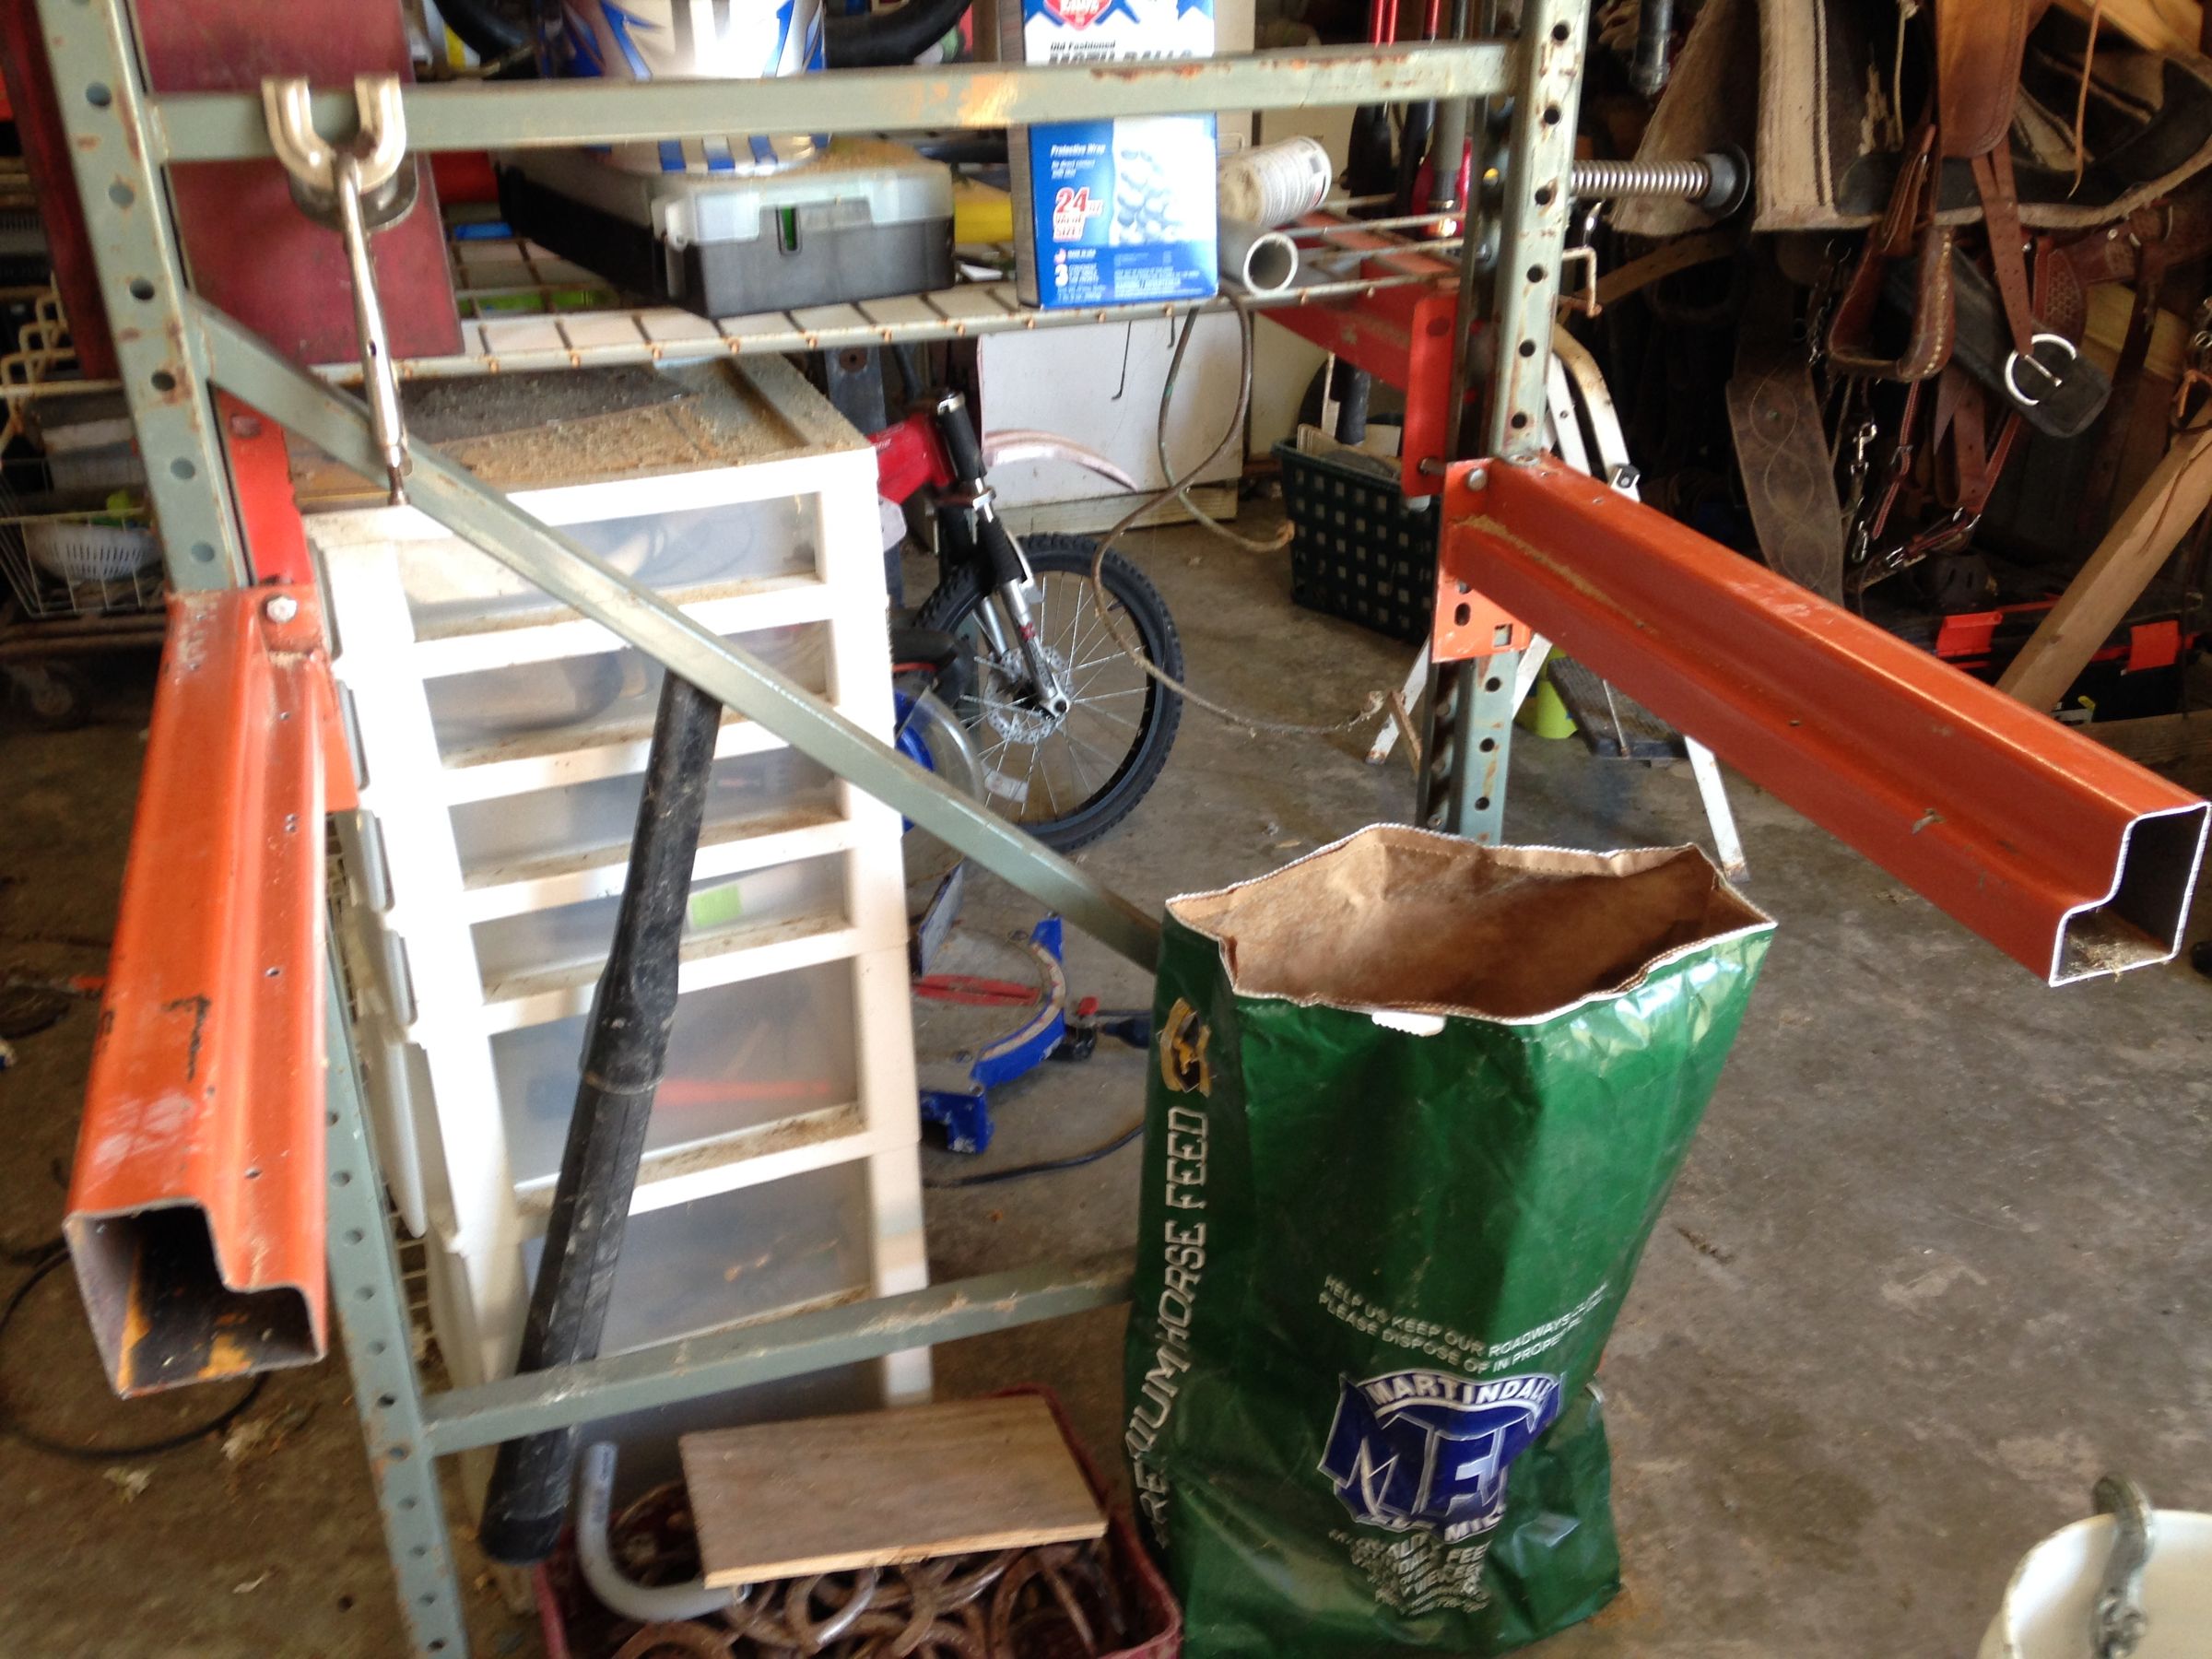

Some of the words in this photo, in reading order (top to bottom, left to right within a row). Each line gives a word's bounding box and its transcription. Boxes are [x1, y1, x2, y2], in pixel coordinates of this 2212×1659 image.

[1054, 187, 1089, 215] 24
[1054, 264, 1068, 288] 3
[1165, 1105, 1208, 1209] FEED
[1155, 1219, 1206, 1352] HORSE
[1319, 1290, 1379, 1336] PLEASE
[1382, 1327, 1462, 1366] DISPOSE
[1463, 1356, 1491, 1374] OF
[1492, 1359, 1512, 1372] IN
[1391, 1315, 1443, 1336] KEEP
[1443, 1330, 1487, 1358] OUR
